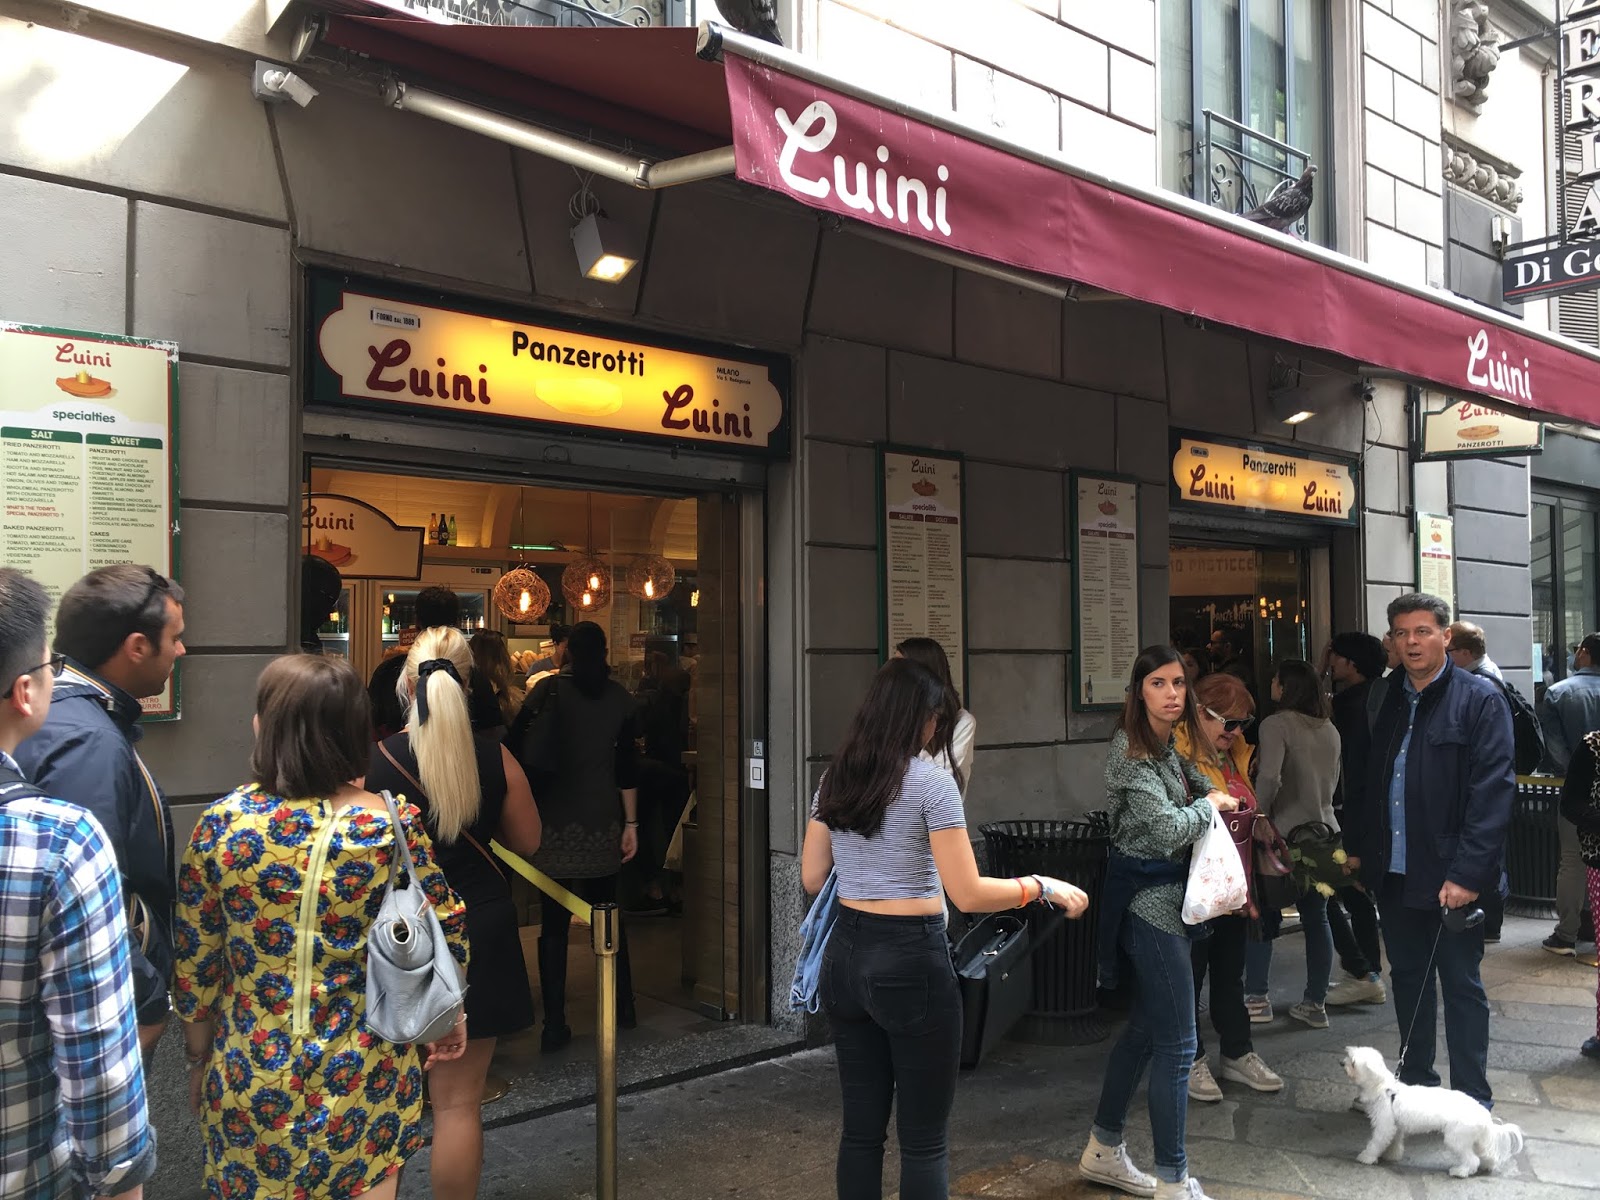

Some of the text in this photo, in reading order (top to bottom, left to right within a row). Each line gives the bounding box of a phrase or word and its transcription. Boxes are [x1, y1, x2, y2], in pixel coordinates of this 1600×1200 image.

[774, 100, 952, 237] Luini
[1514, 256, 1552, 288] Di
[56, 342, 112, 368] Luini
[511, 331, 645, 377] Panzerotti
[1467, 328, 1532, 401] Luini
[366, 338, 491, 406] Luini
[716, 366, 740, 377] MILANO
[52, 410, 116, 424] specialties
[661, 384, 753, 439] Luini
[1458, 402, 1505, 421] Luin
[31, 430, 53, 439] SALT
[111, 437, 140, 446] SWEET
[1457, 440, 1504, 449] PANZEROTTI
[911, 459, 936, 475] Luini
[1242, 454, 1296, 478] Panzerotti
[1098, 483, 1117, 496] Luini
[1189, 464, 1236, 500] Luini
[912, 504, 936, 512] specialità
[1302, 480, 1342, 514] Luini
[302, 505, 355, 531] Luini
